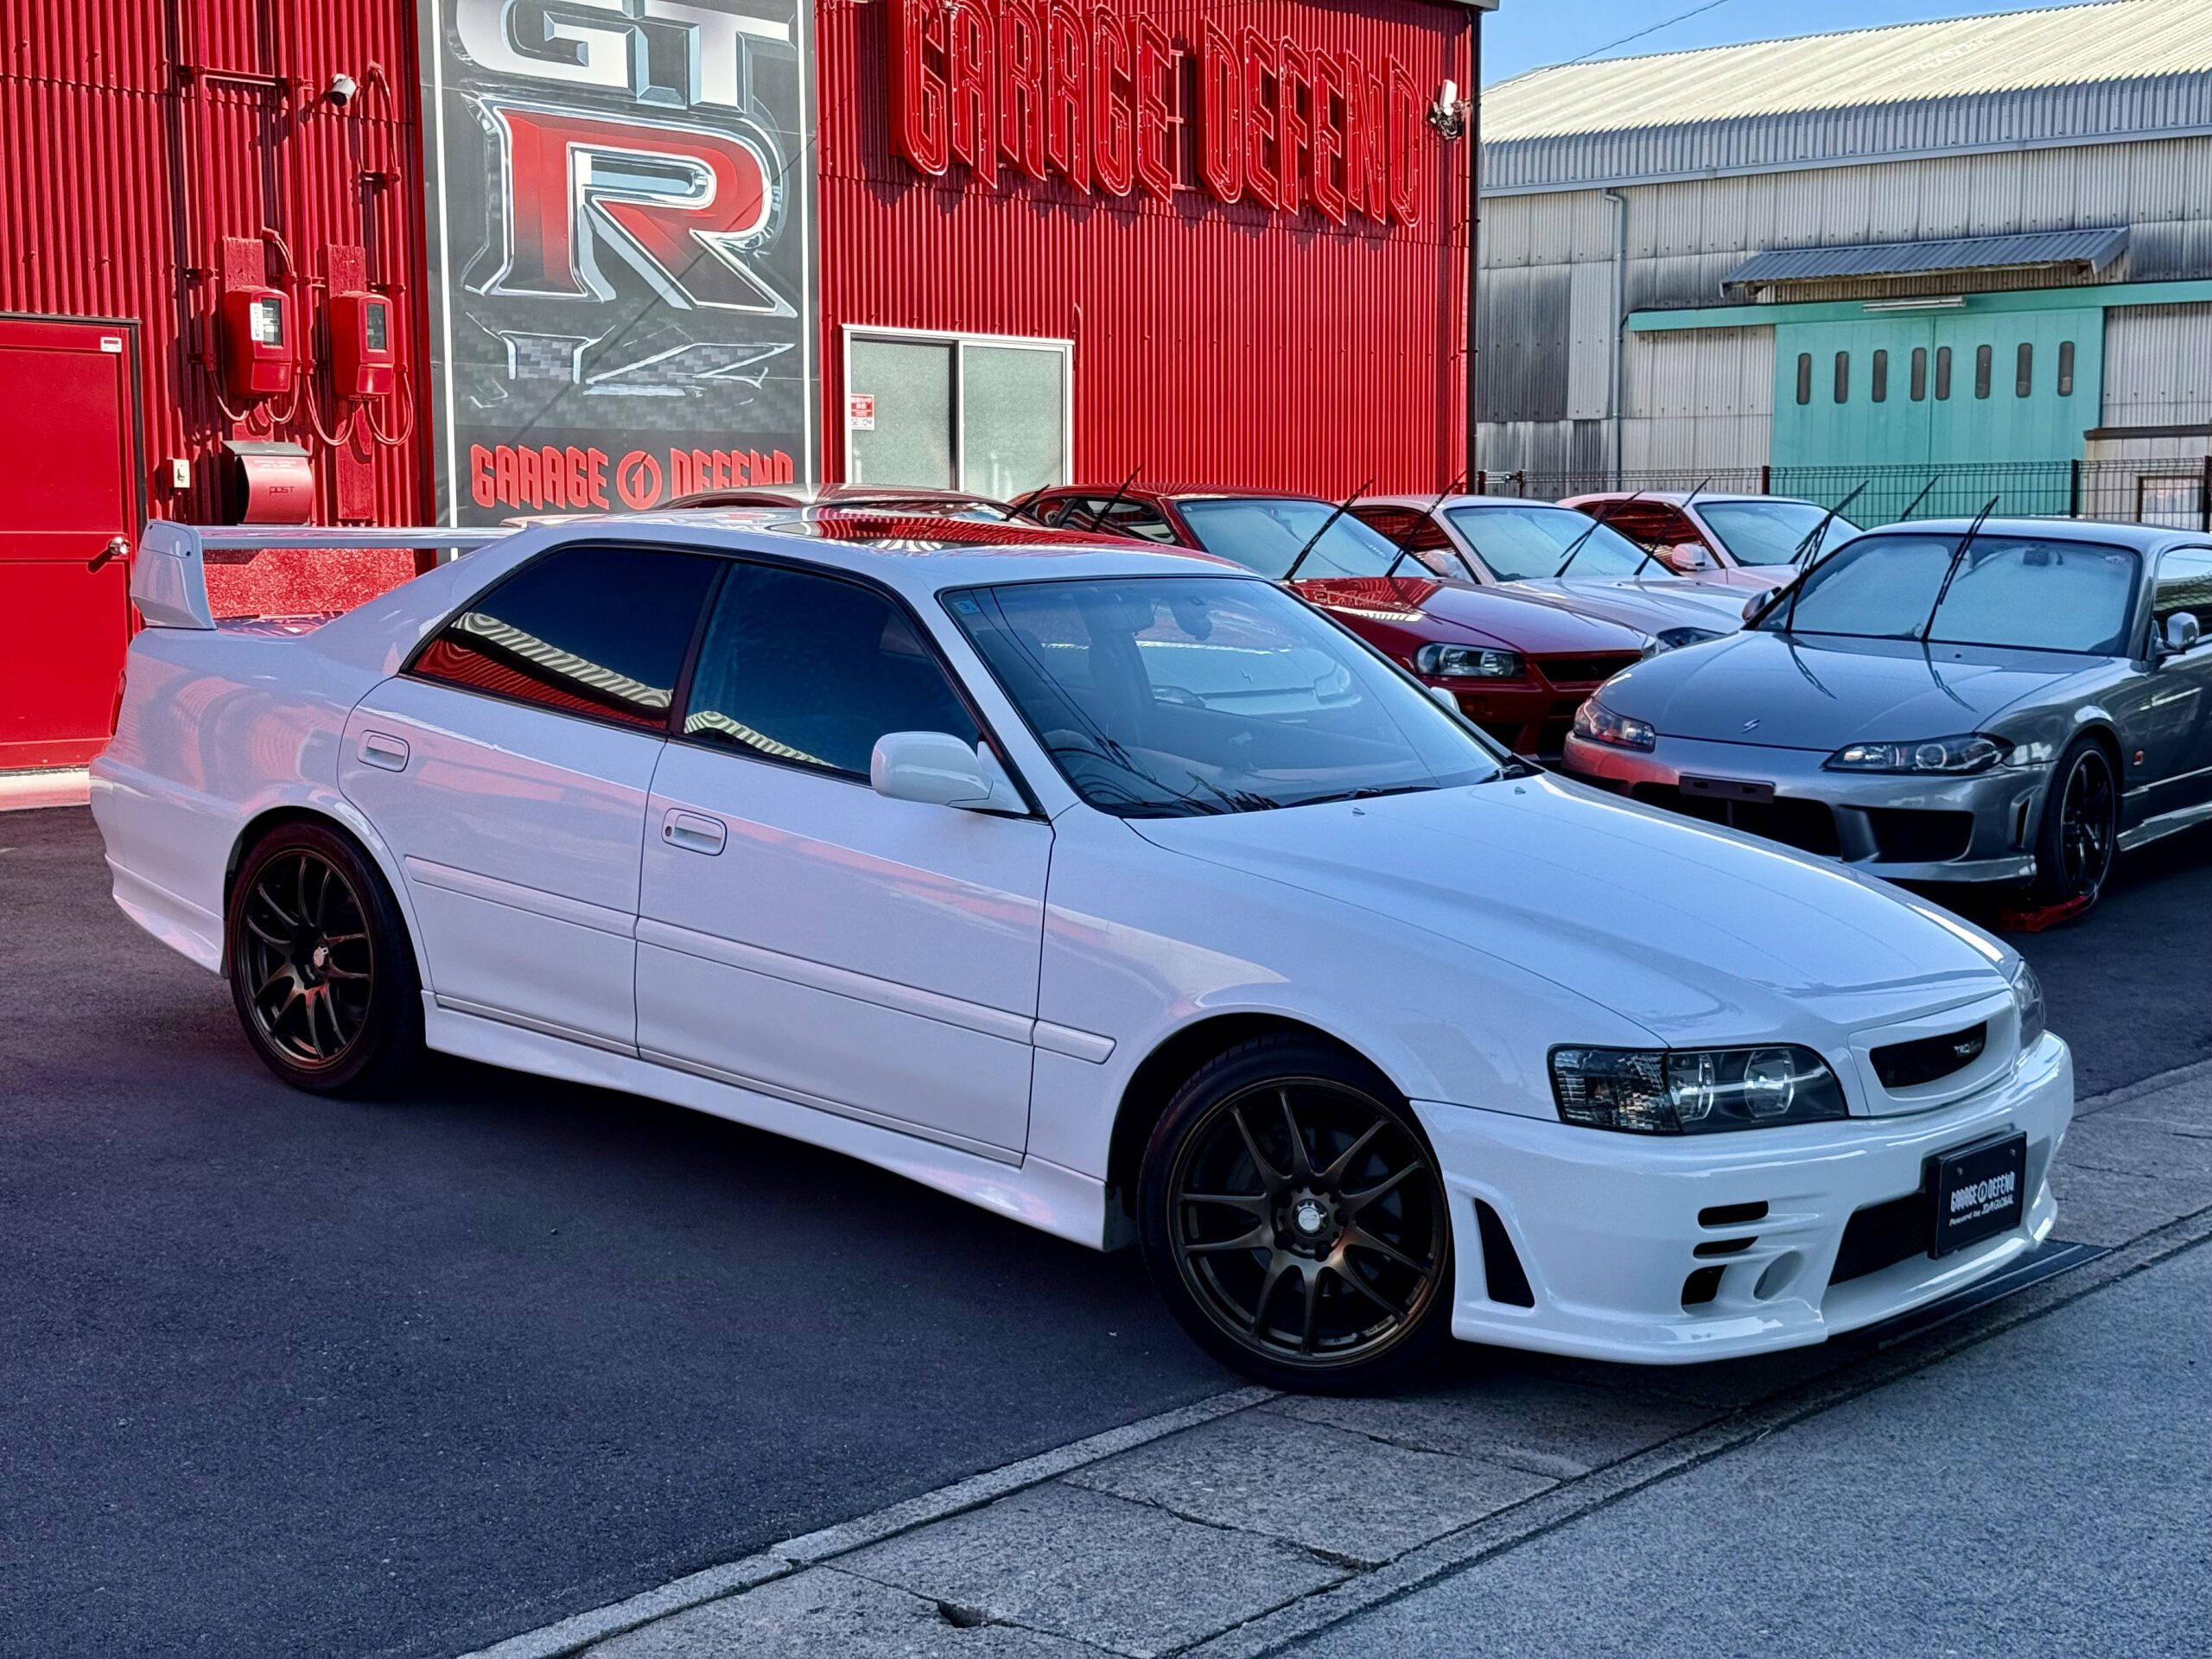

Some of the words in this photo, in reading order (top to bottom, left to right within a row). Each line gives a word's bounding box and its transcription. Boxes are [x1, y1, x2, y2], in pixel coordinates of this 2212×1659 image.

[456, 0, 797, 113] GT
[902, 0, 1173, 206] GARAGE
[1204, 15, 1423, 228] DEFEND
[470, 442, 610, 511] GARAGE
[1987, 1171, 2015, 1199] DEFEND
